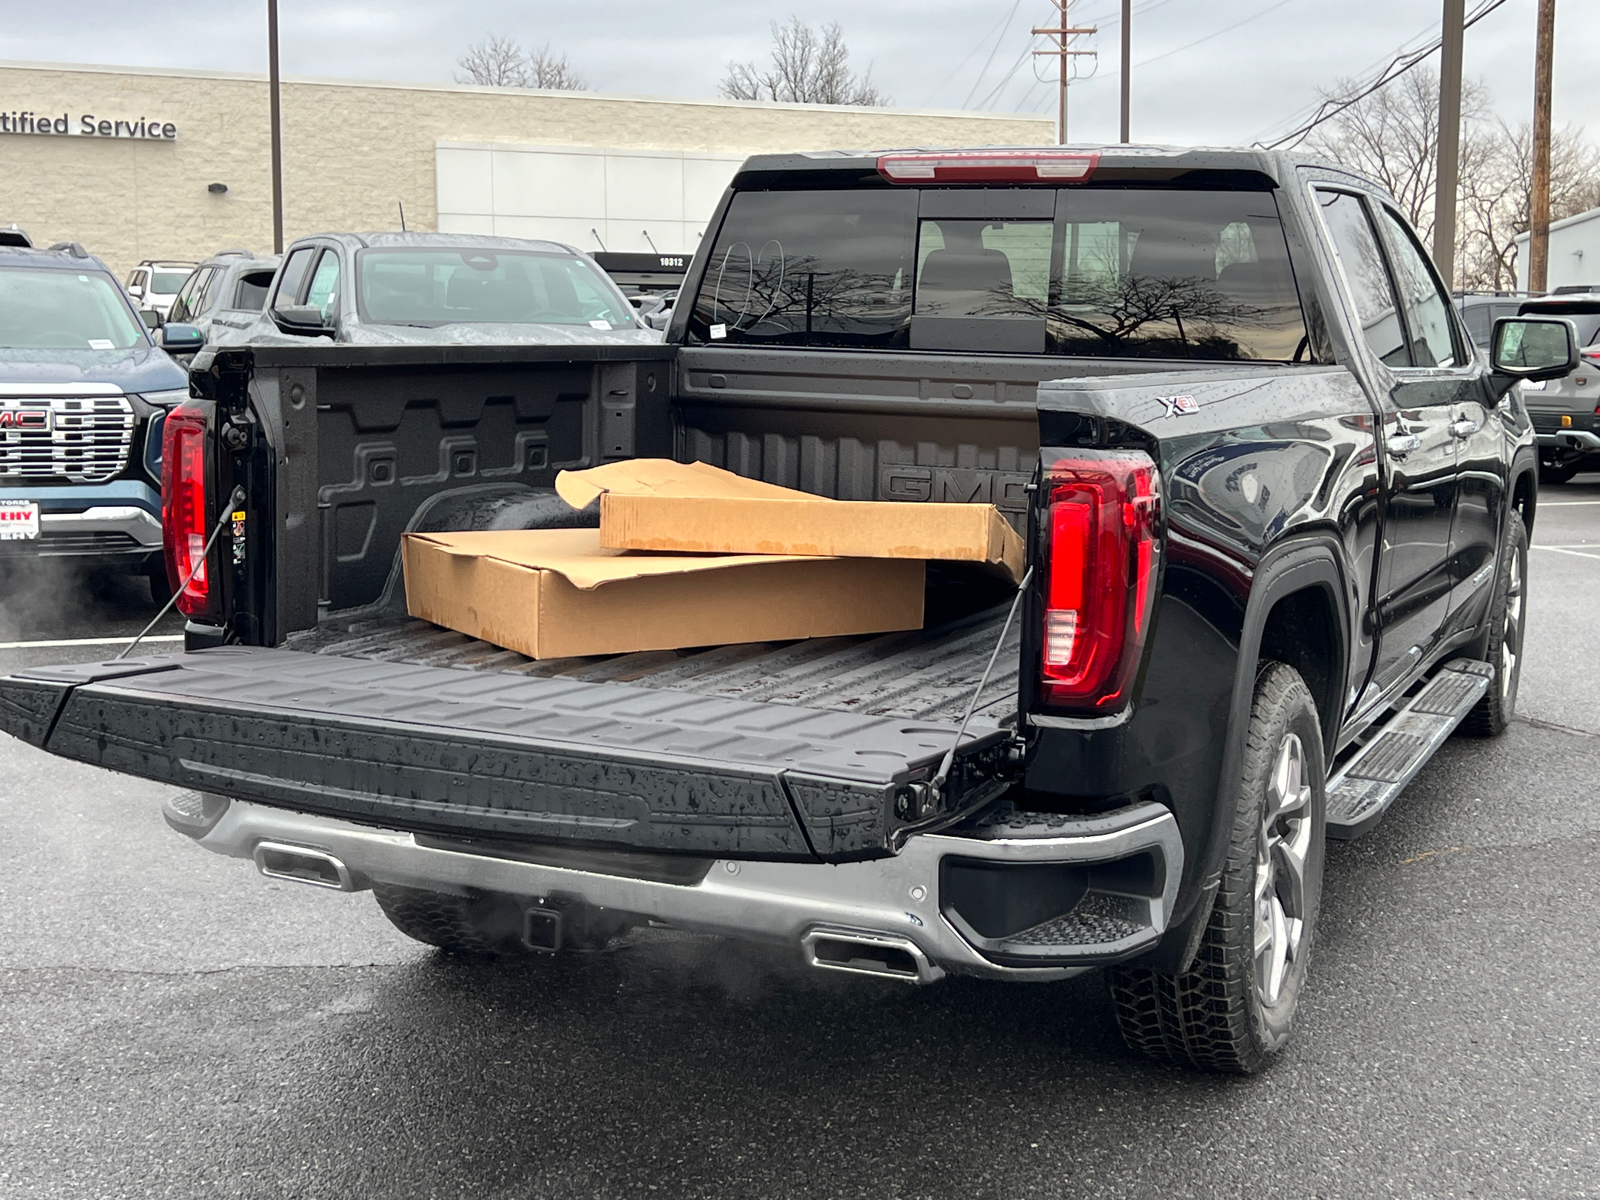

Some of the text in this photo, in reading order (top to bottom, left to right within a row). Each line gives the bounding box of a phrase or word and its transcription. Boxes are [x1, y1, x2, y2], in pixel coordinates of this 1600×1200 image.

[0, 111, 177, 138] tified Service
[660, 257, 684, 267] 10312
[881, 467, 1032, 513] GMC
